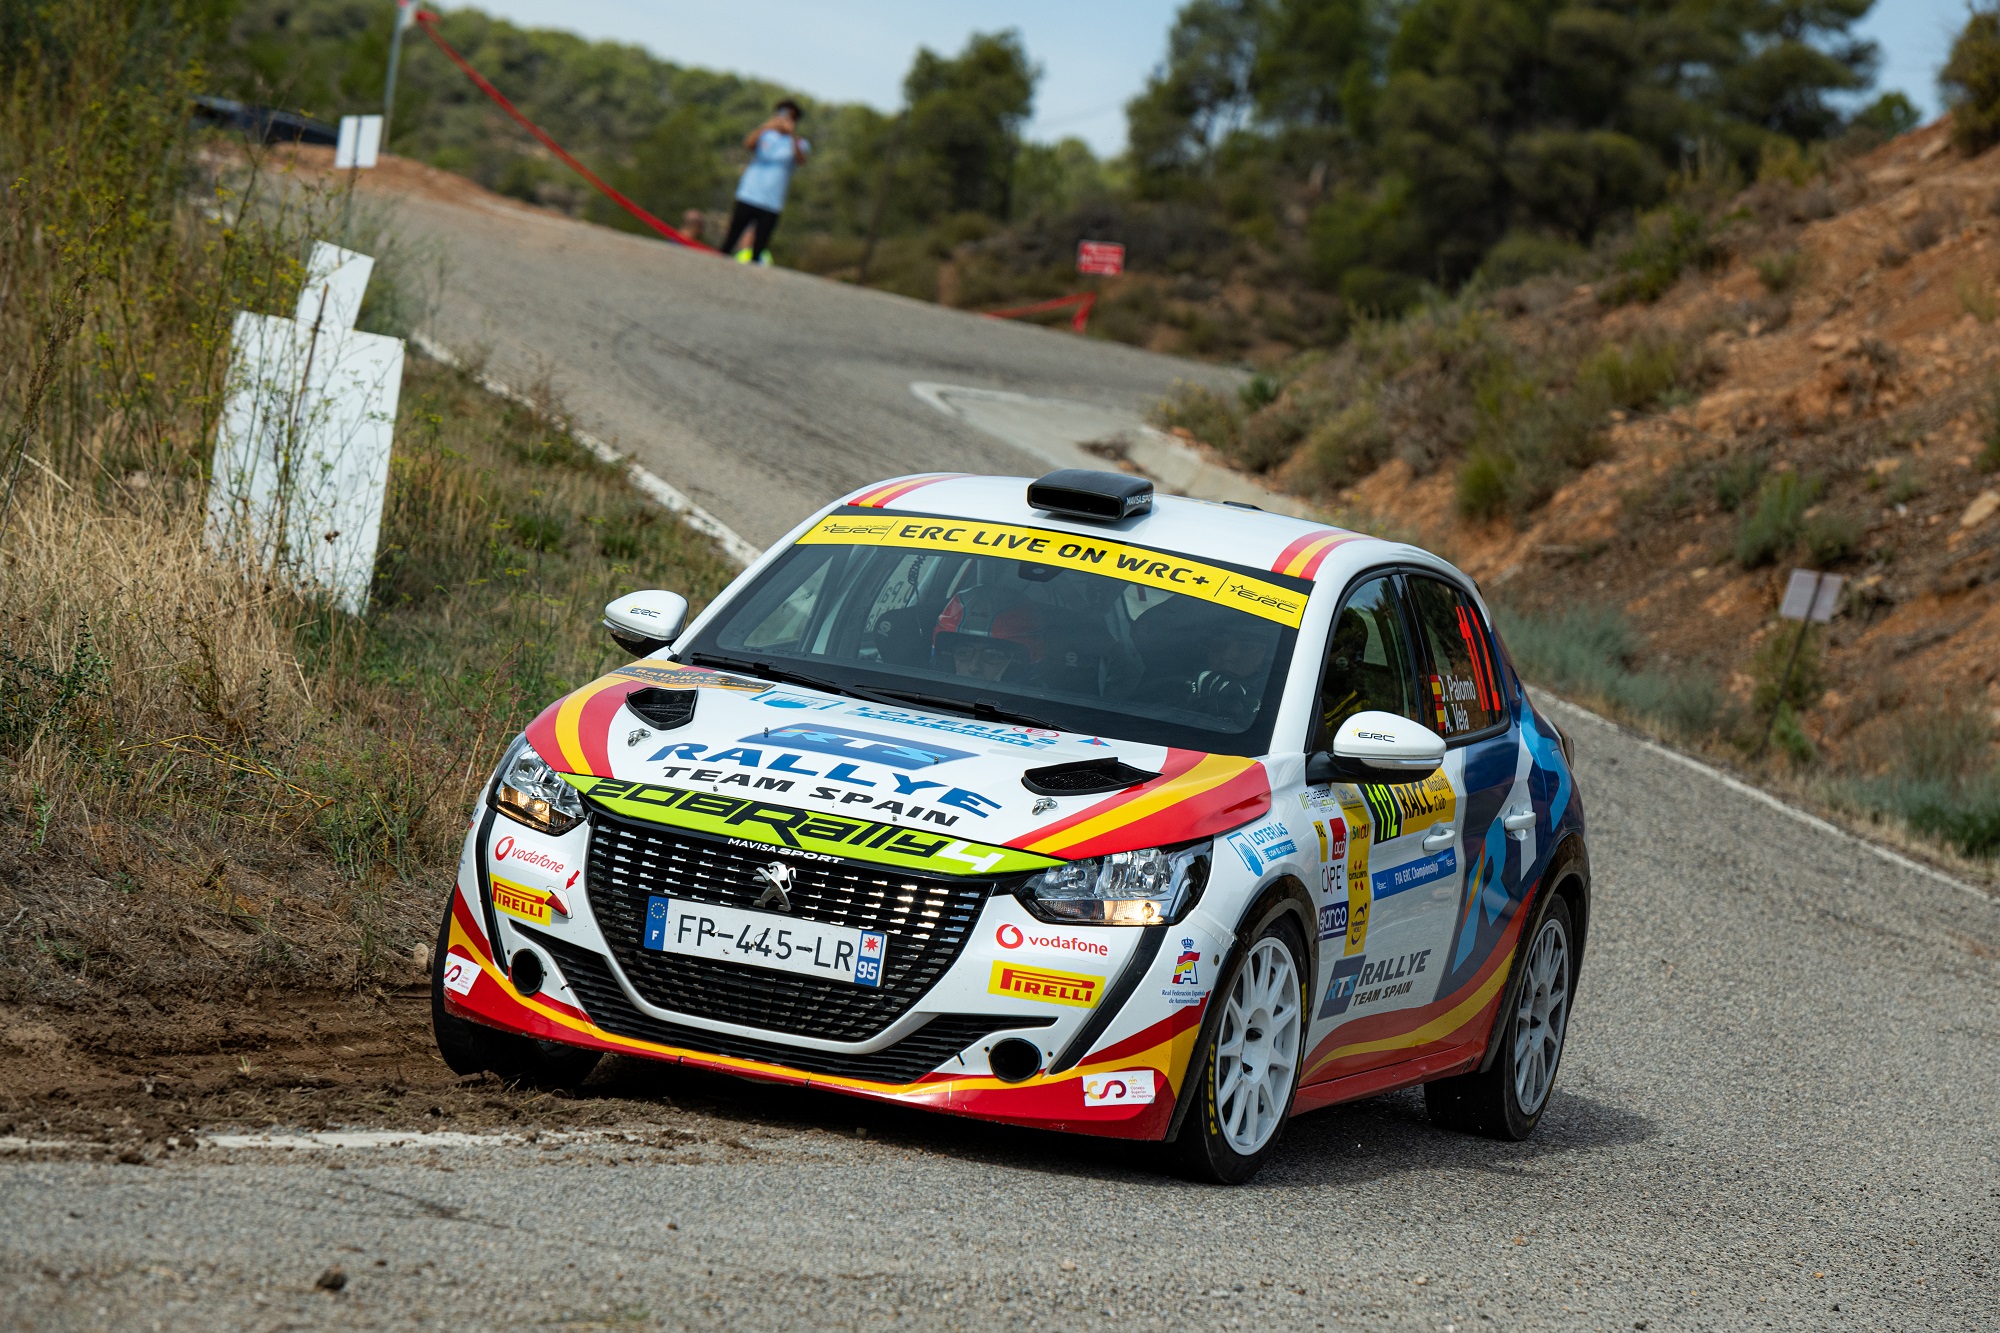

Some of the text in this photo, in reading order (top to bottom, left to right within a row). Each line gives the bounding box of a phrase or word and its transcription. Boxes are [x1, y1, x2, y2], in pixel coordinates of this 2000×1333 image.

[899, 524, 1210, 585] ERC LIVE ON WRC+
[630, 607, 661, 618] ERC
[1446, 674, 1476, 701] Palomo
[1451, 703, 1470, 730] Vela
[1357, 731, 1395, 743] ERC
[646, 742, 1002, 819] RALLYE
[662, 766, 960, 827] TEAM SPAIN
[1393, 780, 1434, 820] RACC
[511, 847, 564, 873] vodafone
[1394, 872, 1404, 886] FIA
[1403, 869, 1412, 883] ERC
[1411, 860, 1439, 880] Championship
[492, 881, 545, 918] PIRELLI
[651, 930, 660, 941] F
[677, 913, 854, 972] FP-445-LR
[1028, 935, 1108, 956] vodafone
[857, 961, 878, 981] 95
[1358, 948, 1432, 987] RALLYE
[1000, 968, 1096, 1002] PIRELLI
[1325, 973, 1359, 1002] RTS
[1353, 980, 1414, 1006] TEAM SPAIN
